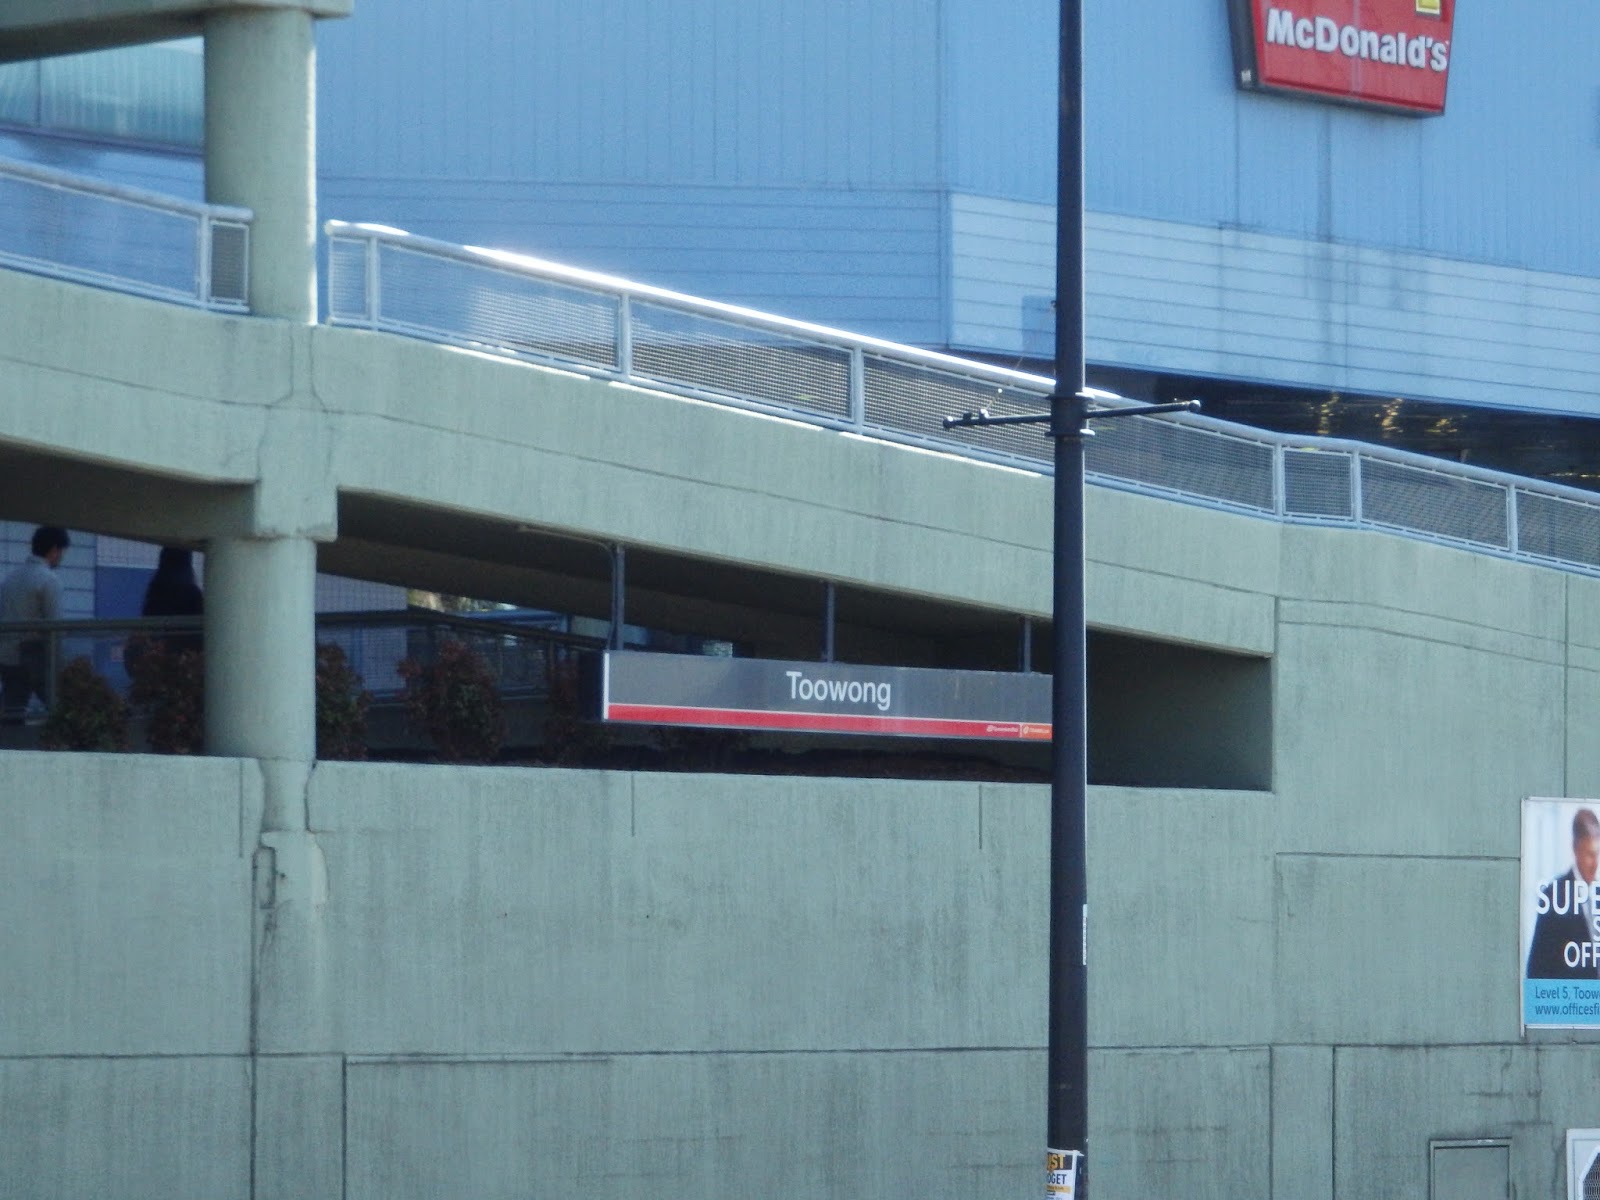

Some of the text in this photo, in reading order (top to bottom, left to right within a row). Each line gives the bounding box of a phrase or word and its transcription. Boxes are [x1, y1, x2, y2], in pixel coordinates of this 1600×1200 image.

[1266, 8, 1448, 72] McDonald's
[786, 671, 891, 711] Toowong
[1535, 986, 1560, 999] Level
[1573, 986, 1600, 1000] Toow
